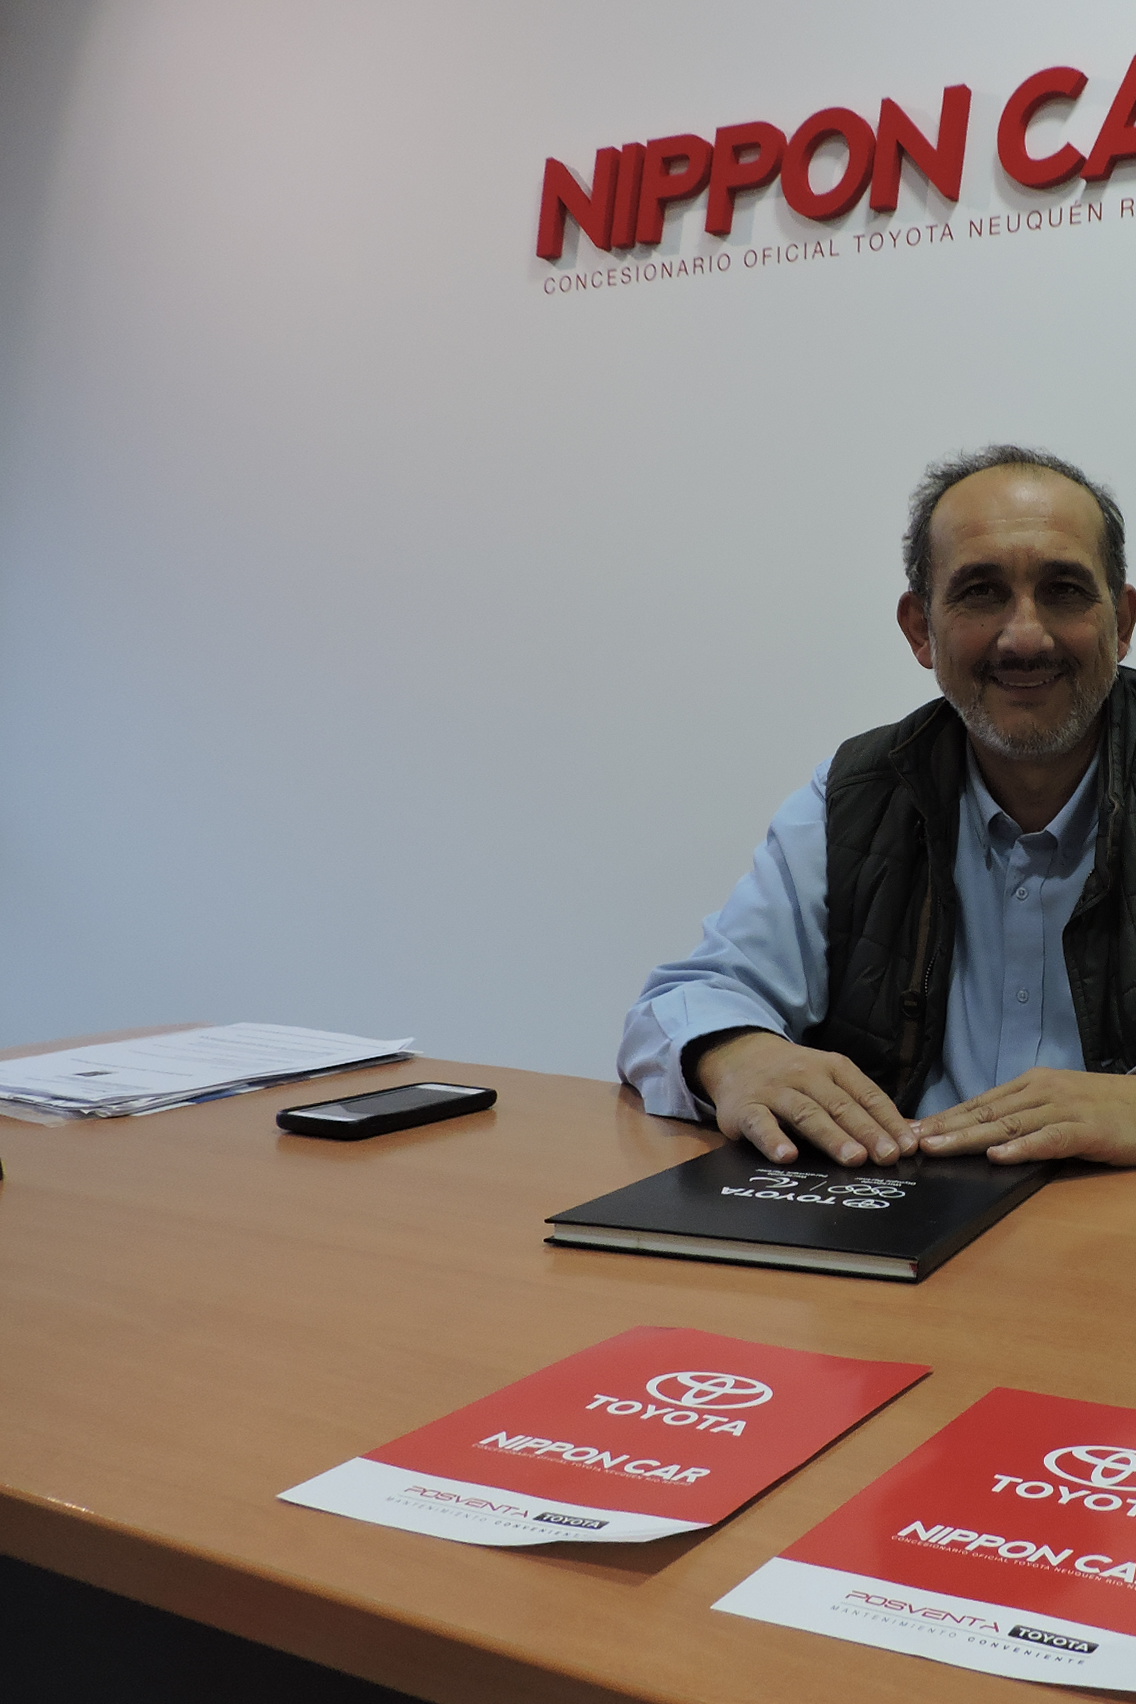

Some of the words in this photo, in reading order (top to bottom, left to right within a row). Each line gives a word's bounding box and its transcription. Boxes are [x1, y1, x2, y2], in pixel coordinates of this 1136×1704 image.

[536, 83, 972, 259] NIPPON
[543, 253, 731, 295] CONCESIONARIO
[743, 238, 840, 269] OFICIAL
[853, 223, 954, 254] TOYOTA
[969, 201, 1103, 237] NEUQUÉN
[721, 1186, 836, 1204] TOYOTA
[585, 1394, 747, 1436] TOYOTA
[479, 1431, 630, 1468] NIPPON
[624, 1459, 711, 1483] CAR
[386, 1496, 487, 1522] MANTENIMIENTO
[404, 1485, 529, 1519] POSVENTA
[543, 1513, 600, 1529] TOYOTA
[891, 1535, 969, 1555] CONCESIONARIO
[972, 1552, 1009, 1563] OFICIAL
[1013, 1559, 1051, 1571] TOYOTA
[897, 1520, 1074, 1566] NIPPON
[830, 1604, 957, 1638] MANTENIMIENTO
[967, 1636, 1086, 1665] CONVENIENTE
[845, 1590, 1000, 1633] POSVENTA
[1018, 1627, 1090, 1653] TOYOTA
